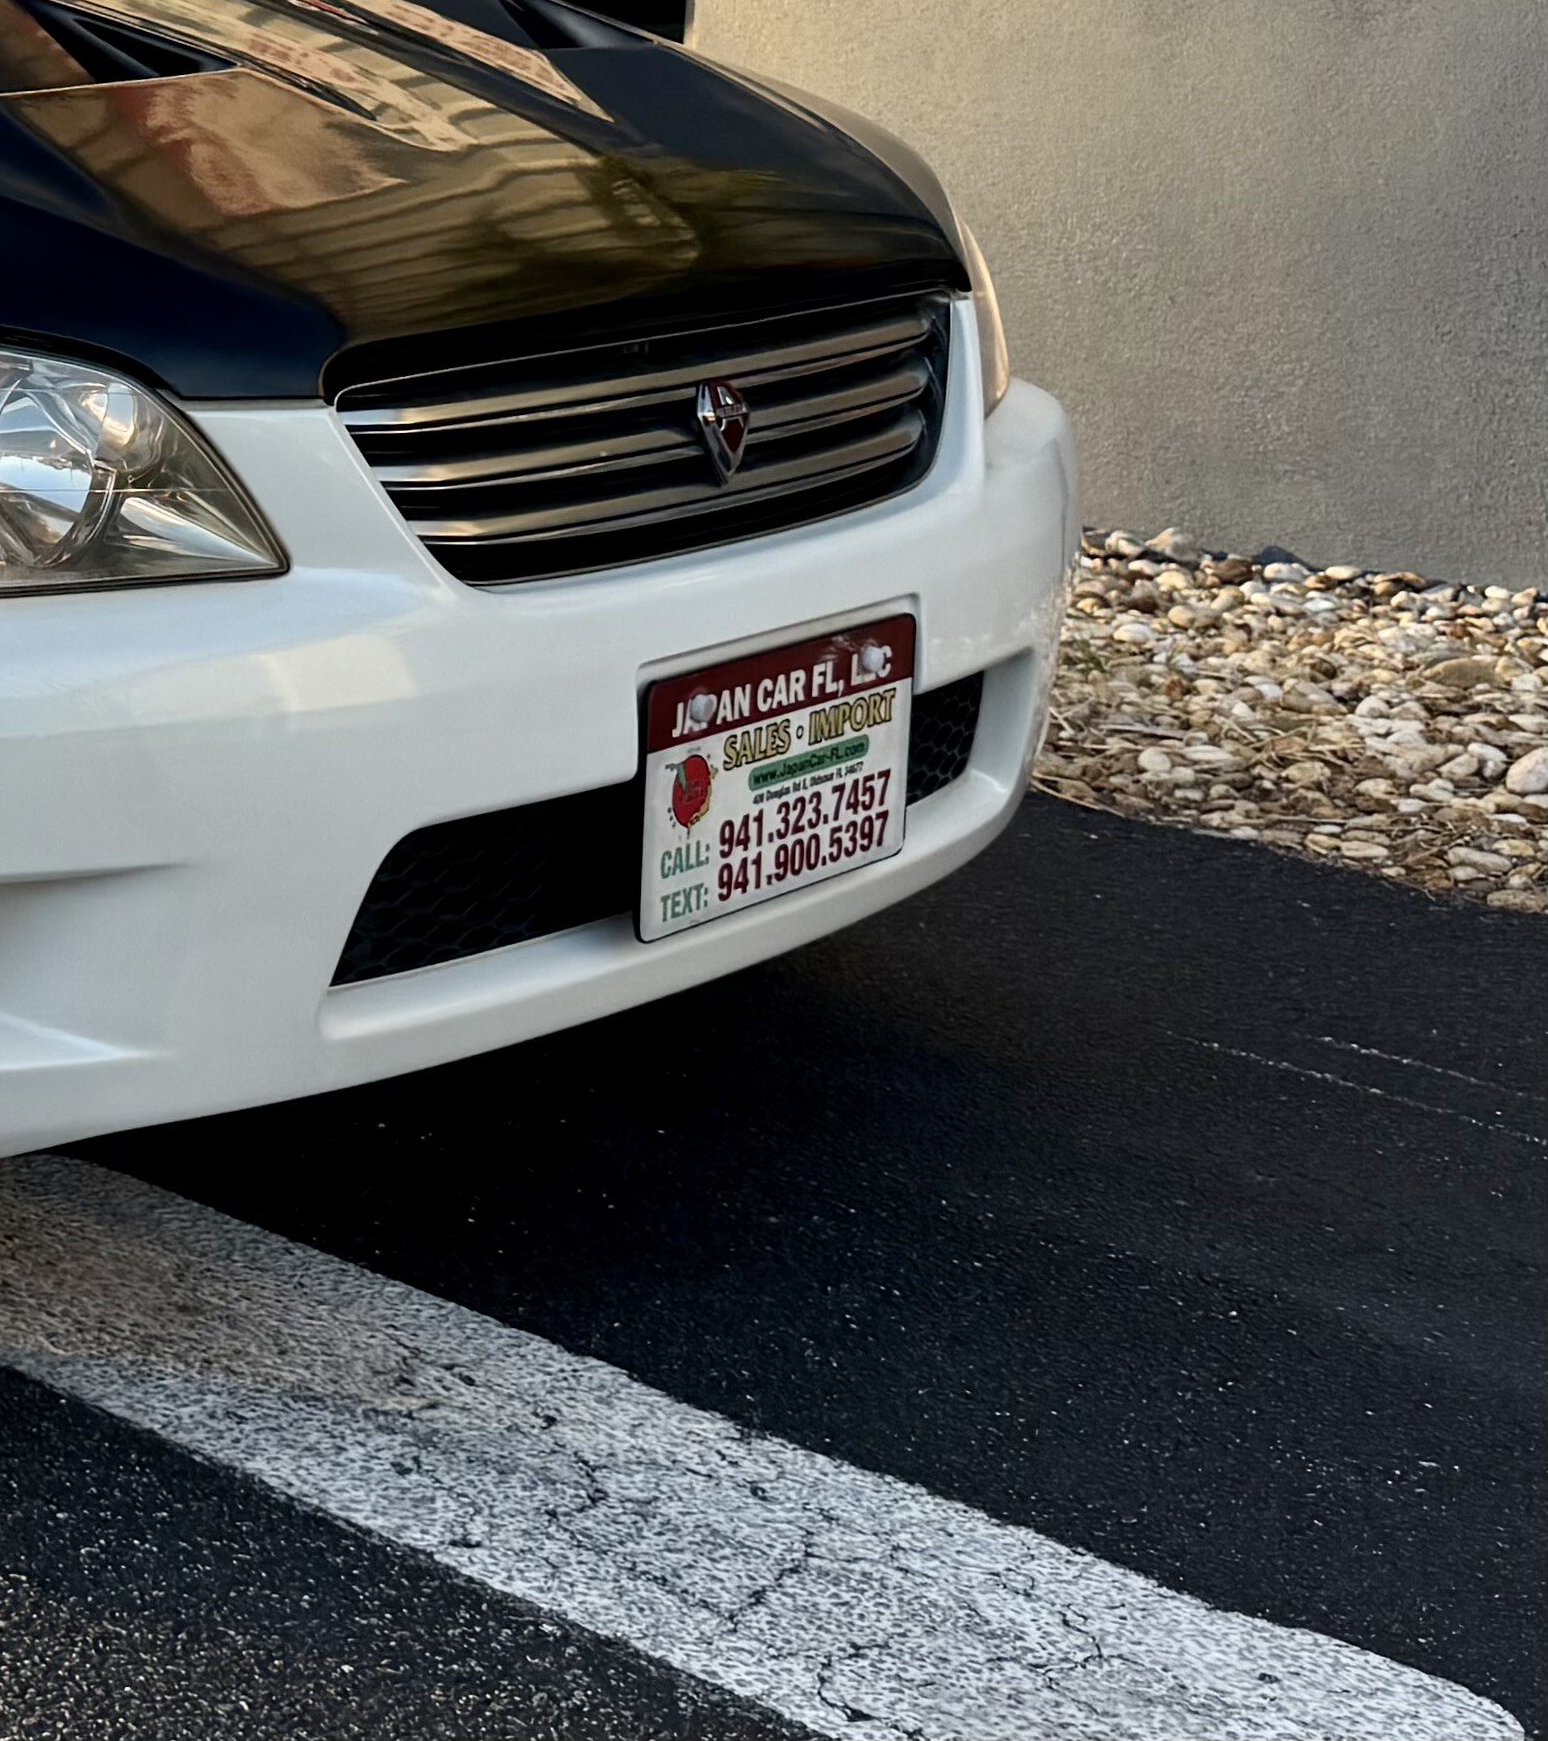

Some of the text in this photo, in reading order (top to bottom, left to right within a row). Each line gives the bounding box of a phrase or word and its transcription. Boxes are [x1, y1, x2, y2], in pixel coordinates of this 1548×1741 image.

[723, 686, 897, 771] SALES IMPORT
[757, 669, 806, 712] CAR
[811, 662, 845, 697] FL,
[659, 809, 890, 922] TEXT: 941.900.5397
[660, 769, 891, 880] CALL: 941.323.7457
